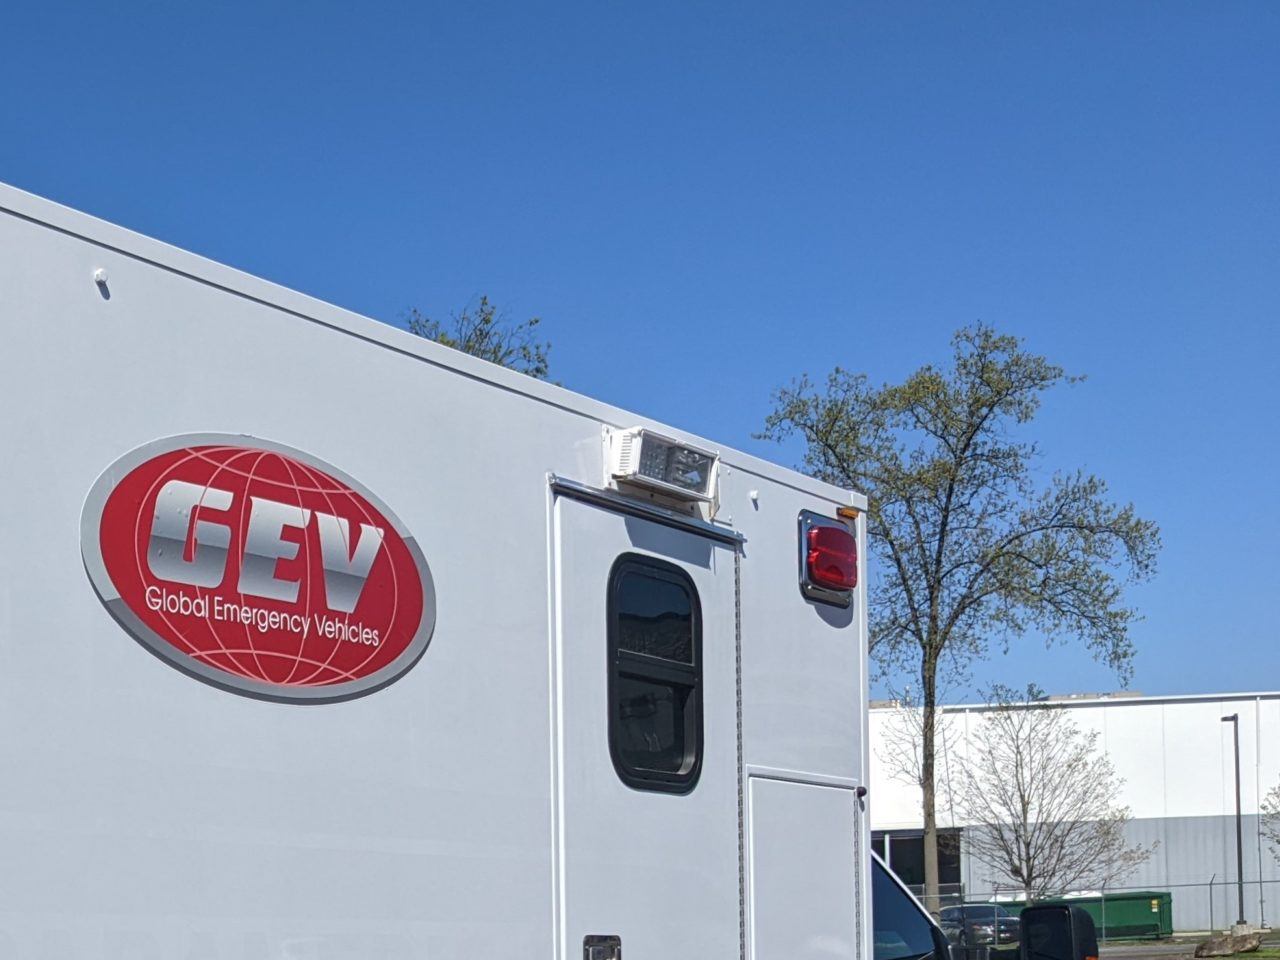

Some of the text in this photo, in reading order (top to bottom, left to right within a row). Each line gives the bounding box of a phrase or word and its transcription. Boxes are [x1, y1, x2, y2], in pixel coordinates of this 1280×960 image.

[147, 479, 385, 614] GEV
[145, 586, 380, 647] Global Emergency Vehicles
